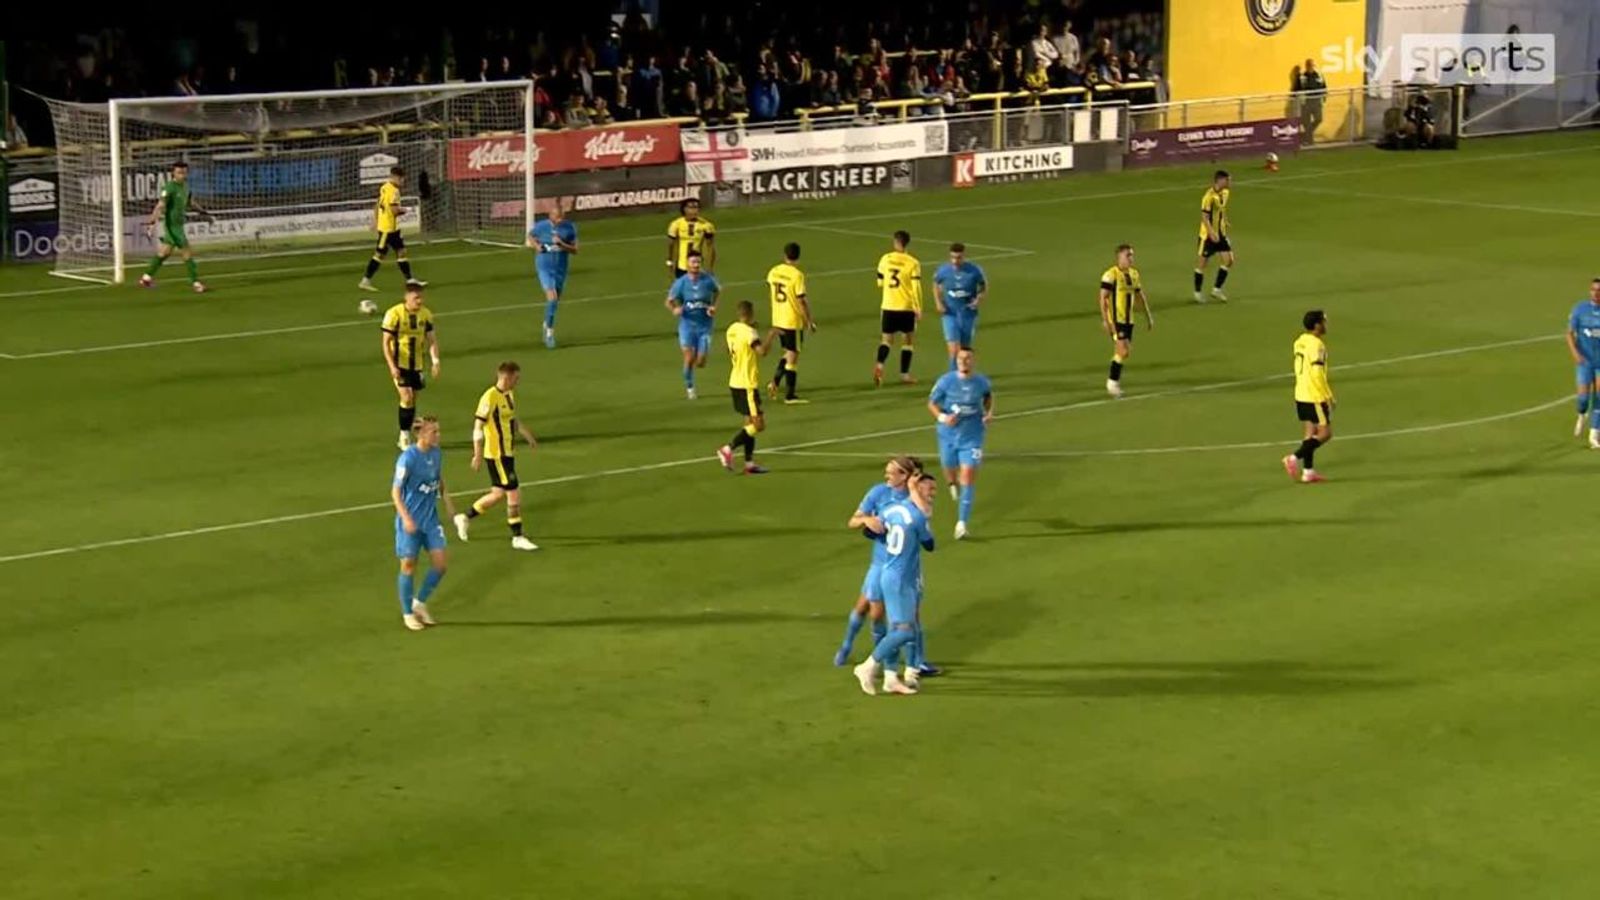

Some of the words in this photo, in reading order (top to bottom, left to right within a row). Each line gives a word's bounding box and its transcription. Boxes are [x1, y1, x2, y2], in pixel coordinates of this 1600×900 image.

[584, 131, 657, 162] Kellogg's
[751, 147, 775, 161] SMH
[956, 158, 974, 183] K
[985, 151, 1062, 172] KITCHING
[80, 174, 121, 204] YOU
[741, 171, 810, 194] BLACK
[819, 165, 888, 189] SHEEP
[888, 268, 900, 288] 3
[773, 281, 787, 303] 15
